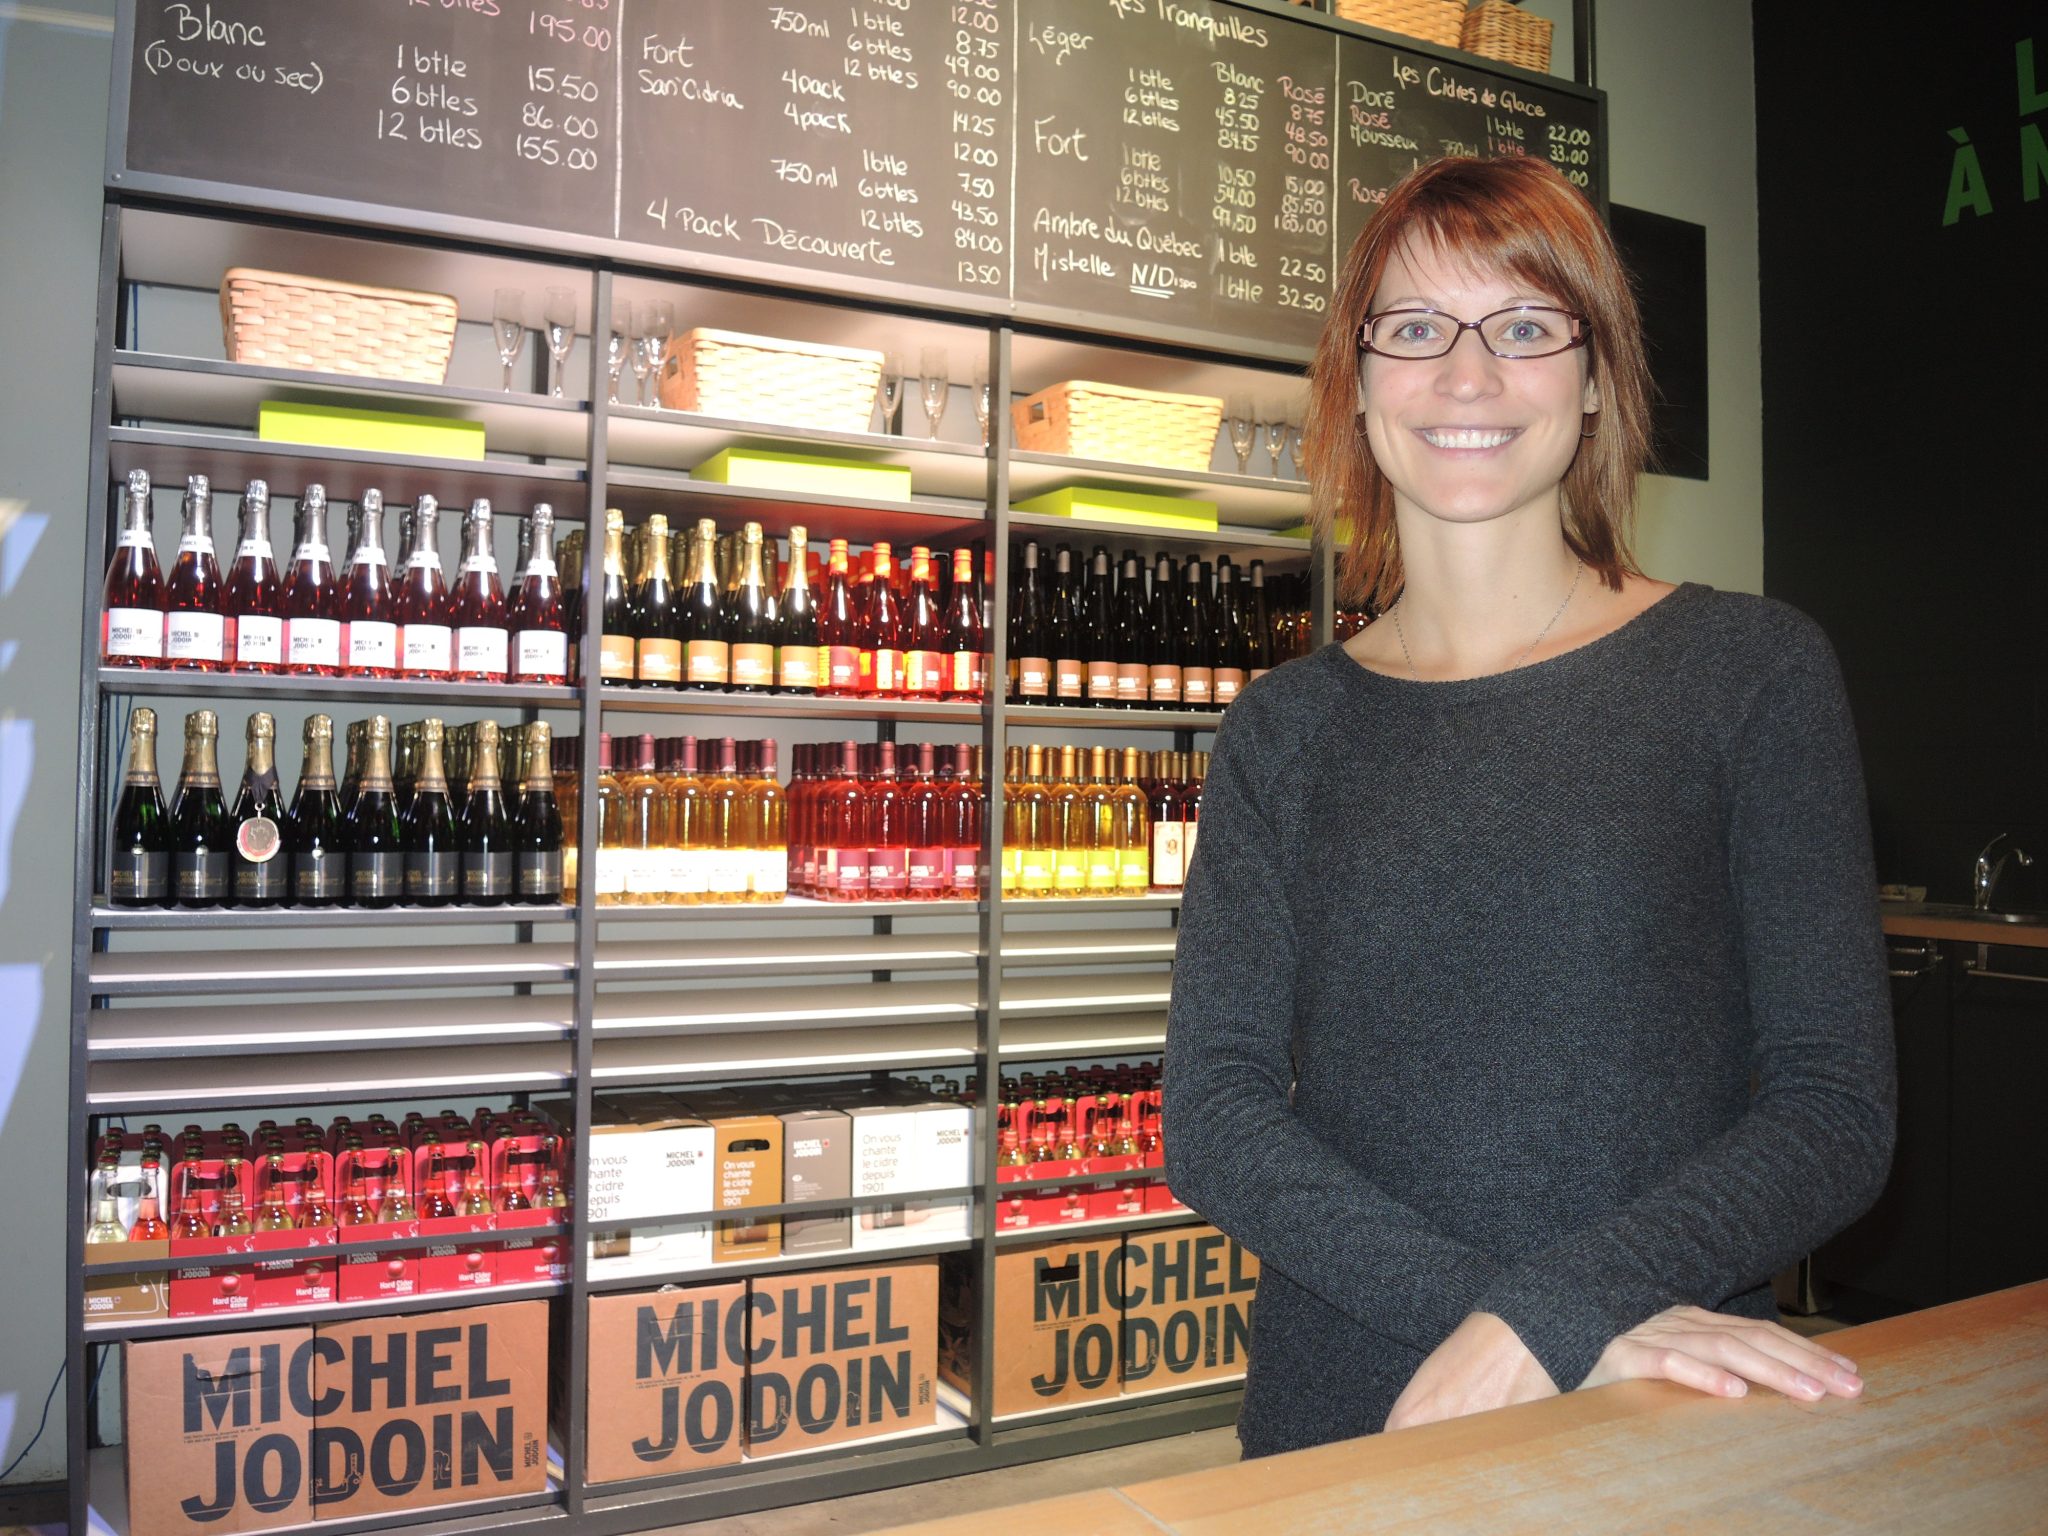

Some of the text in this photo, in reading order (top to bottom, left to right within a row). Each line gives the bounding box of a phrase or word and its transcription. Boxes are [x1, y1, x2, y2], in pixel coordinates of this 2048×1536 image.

[165, 3, 266, 47] Blanc
[528, 11, 610, 51] 195.00
[951, 7, 999, 34] 12.00
[1157, 0, 1268, 48] Tranquilles
[863, 11, 904, 37] btle
[955, 31, 999, 58] 8.75
[1030, 22, 1095, 65] Léger
[643, 34, 694, 68] Fort
[847, 34, 1000, 83] 6 btles 49.00
[237, 64, 265, 84] ou
[414, 47, 467, 78] btle
[528, 66, 598, 100] 15.50
[844, 58, 862, 77] 12
[868, 61, 919, 89] btles
[1139, 69, 1174, 91] btle
[1211, 61, 1326, 104] Blanc Rosé
[1393, 56, 1420, 90] Les
[1427, 66, 1478, 104] Cidres
[1500, 91, 1546, 117] Glace
[1347, 81, 1395, 110] Doré
[415, 82, 478, 116] btles
[523, 103, 598, 139] 86.00
[952, 111, 996, 136] 14.25
[1123, 108, 1141, 126] 12
[1142, 111, 1181, 132] btles
[1140, 90, 1180, 110] btles
[1215, 108, 1260, 132] 45.50
[1350, 105, 1392, 130] Rosé
[379, 112, 598, 171] 12 btles 155.00
[1034, 115, 1088, 161] Fort
[1350, 125, 1419, 150] Mousseux
[1495, 117, 1525, 140] btle
[1942, 126, 1993, 227] À
[860, 209, 880, 230] 12
[951, 201, 999, 226] 43.50
[646, 198, 668, 230] 4
[675, 207, 741, 241] Pack
[752, 218, 895, 266] Découverte
[1033, 207, 1100, 239] Ambre
[1104, 216, 1133, 248] du
[1136, 227, 1203, 258] Québec
[1229, 242, 1259, 267] btle
[1280, 256, 1326, 283] 22.50
[1034, 243, 1116, 282] Mistelle
[1228, 276, 1263, 301] btle
[1278, 285, 1326, 312] 32.50
[863, 1133, 901, 1144] On vous
[936, 1129, 961, 1137] MICHEL
[601, 1156, 628, 1164] vous
[666, 1159, 695, 1168] JODOIN
[667, 1151, 694, 1159] MICHEL
[863, 1145, 896, 1156] chante
[874, 1158, 898, 1167] cidre
[723, 1160, 755, 1170] On vous
[723, 1170, 751, 1179] chante
[863, 1169, 895, 1181] depuis
[595, 1181, 624, 1192] cidre
[723, 1188, 750, 1198] depuis
[732, 1178, 752, 1187] cidre
[535, 1265, 550, 1273] Hard
[1034, 1234, 1256, 1322] MICHEL
[296, 1288, 312, 1296] Hard
[380, 1281, 396, 1289] Hard
[212, 1296, 248, 1306] Hard Cider
[636, 1276, 910, 1379] MICHEL
[183, 1323, 511, 1434] MICHEL
[632, 1350, 911, 1462] JODOIN
[180, 1406, 514, 1523] JODOIN
